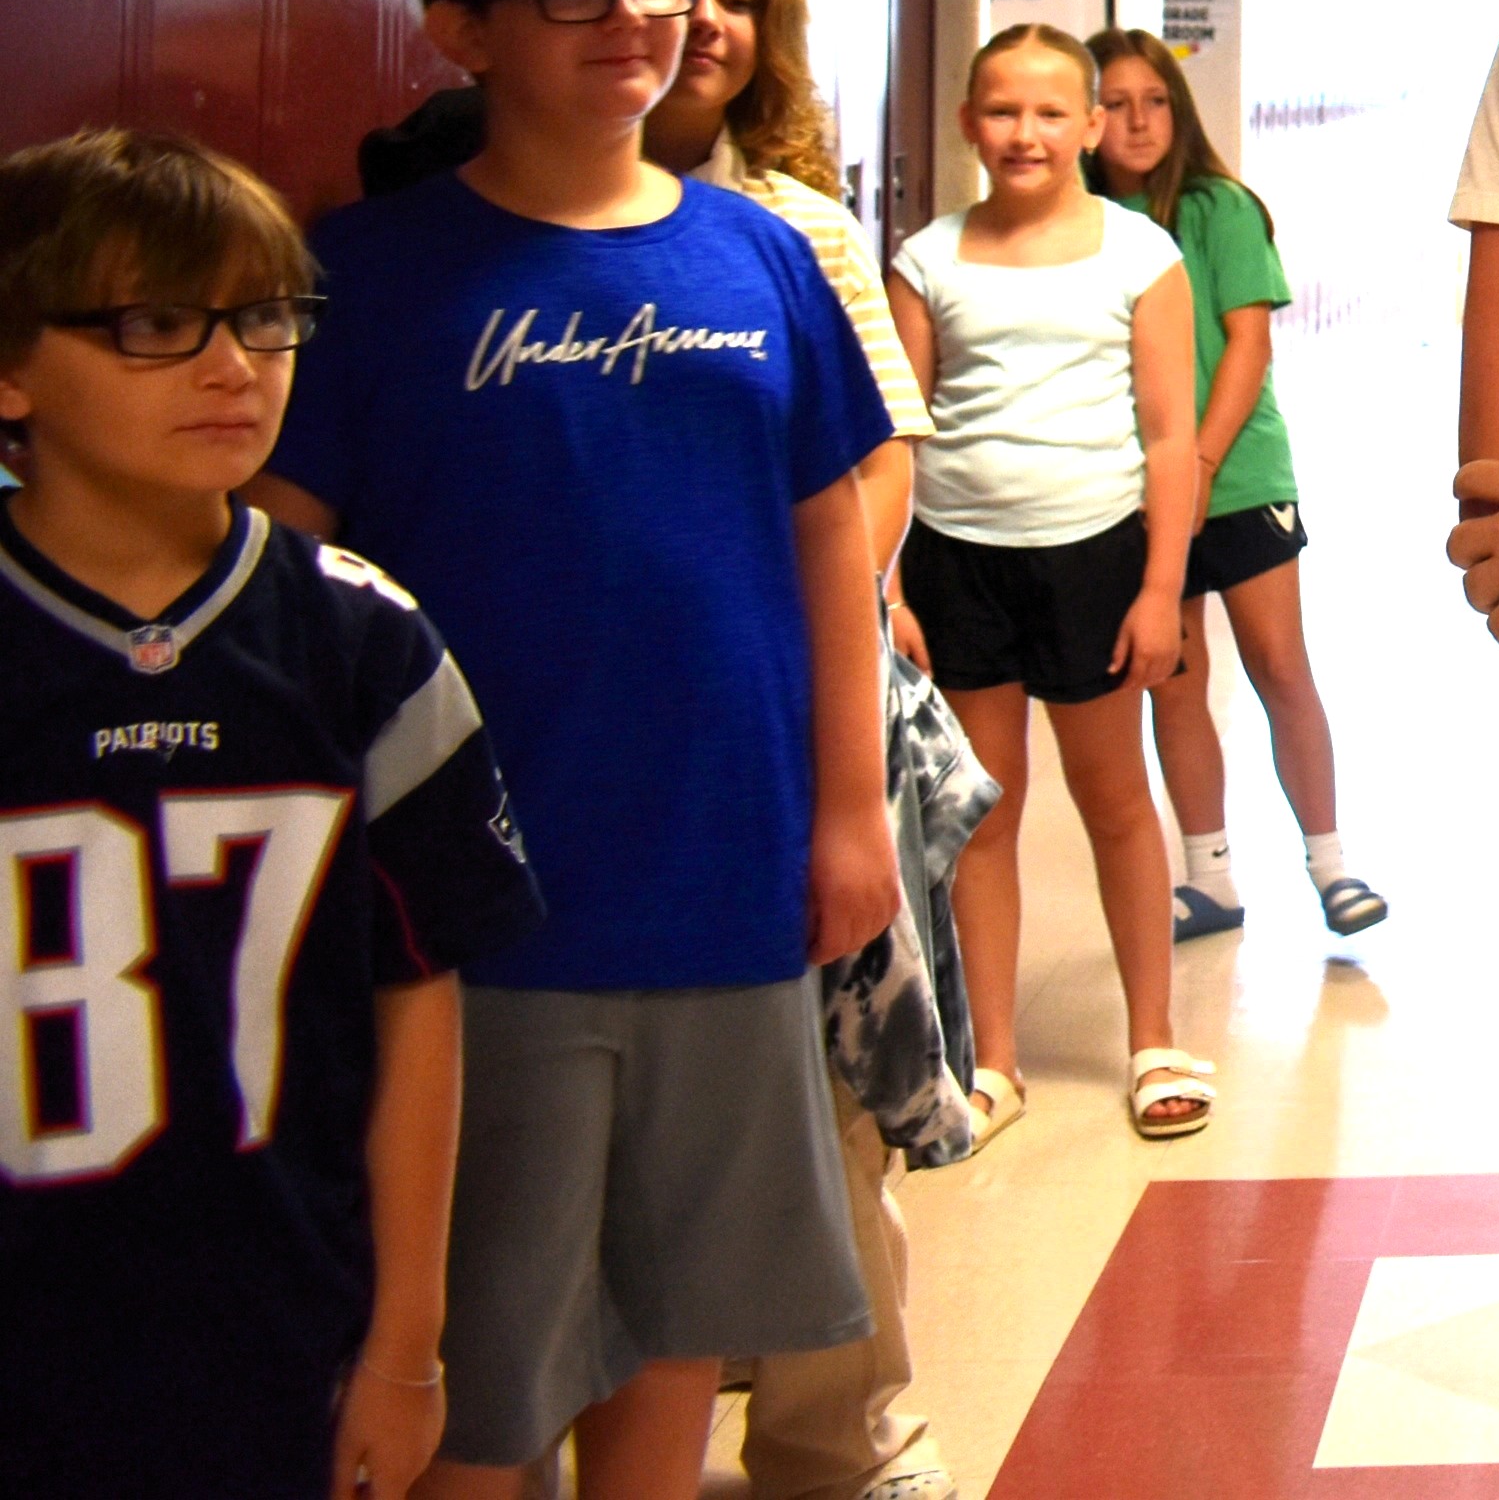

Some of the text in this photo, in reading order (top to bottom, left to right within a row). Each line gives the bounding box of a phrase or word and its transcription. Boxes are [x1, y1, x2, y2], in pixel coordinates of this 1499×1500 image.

[465, 302, 768, 391] Under Armour
[94, 721, 220, 758] PATRIOTS
[0, 783, 355, 1187] 87
